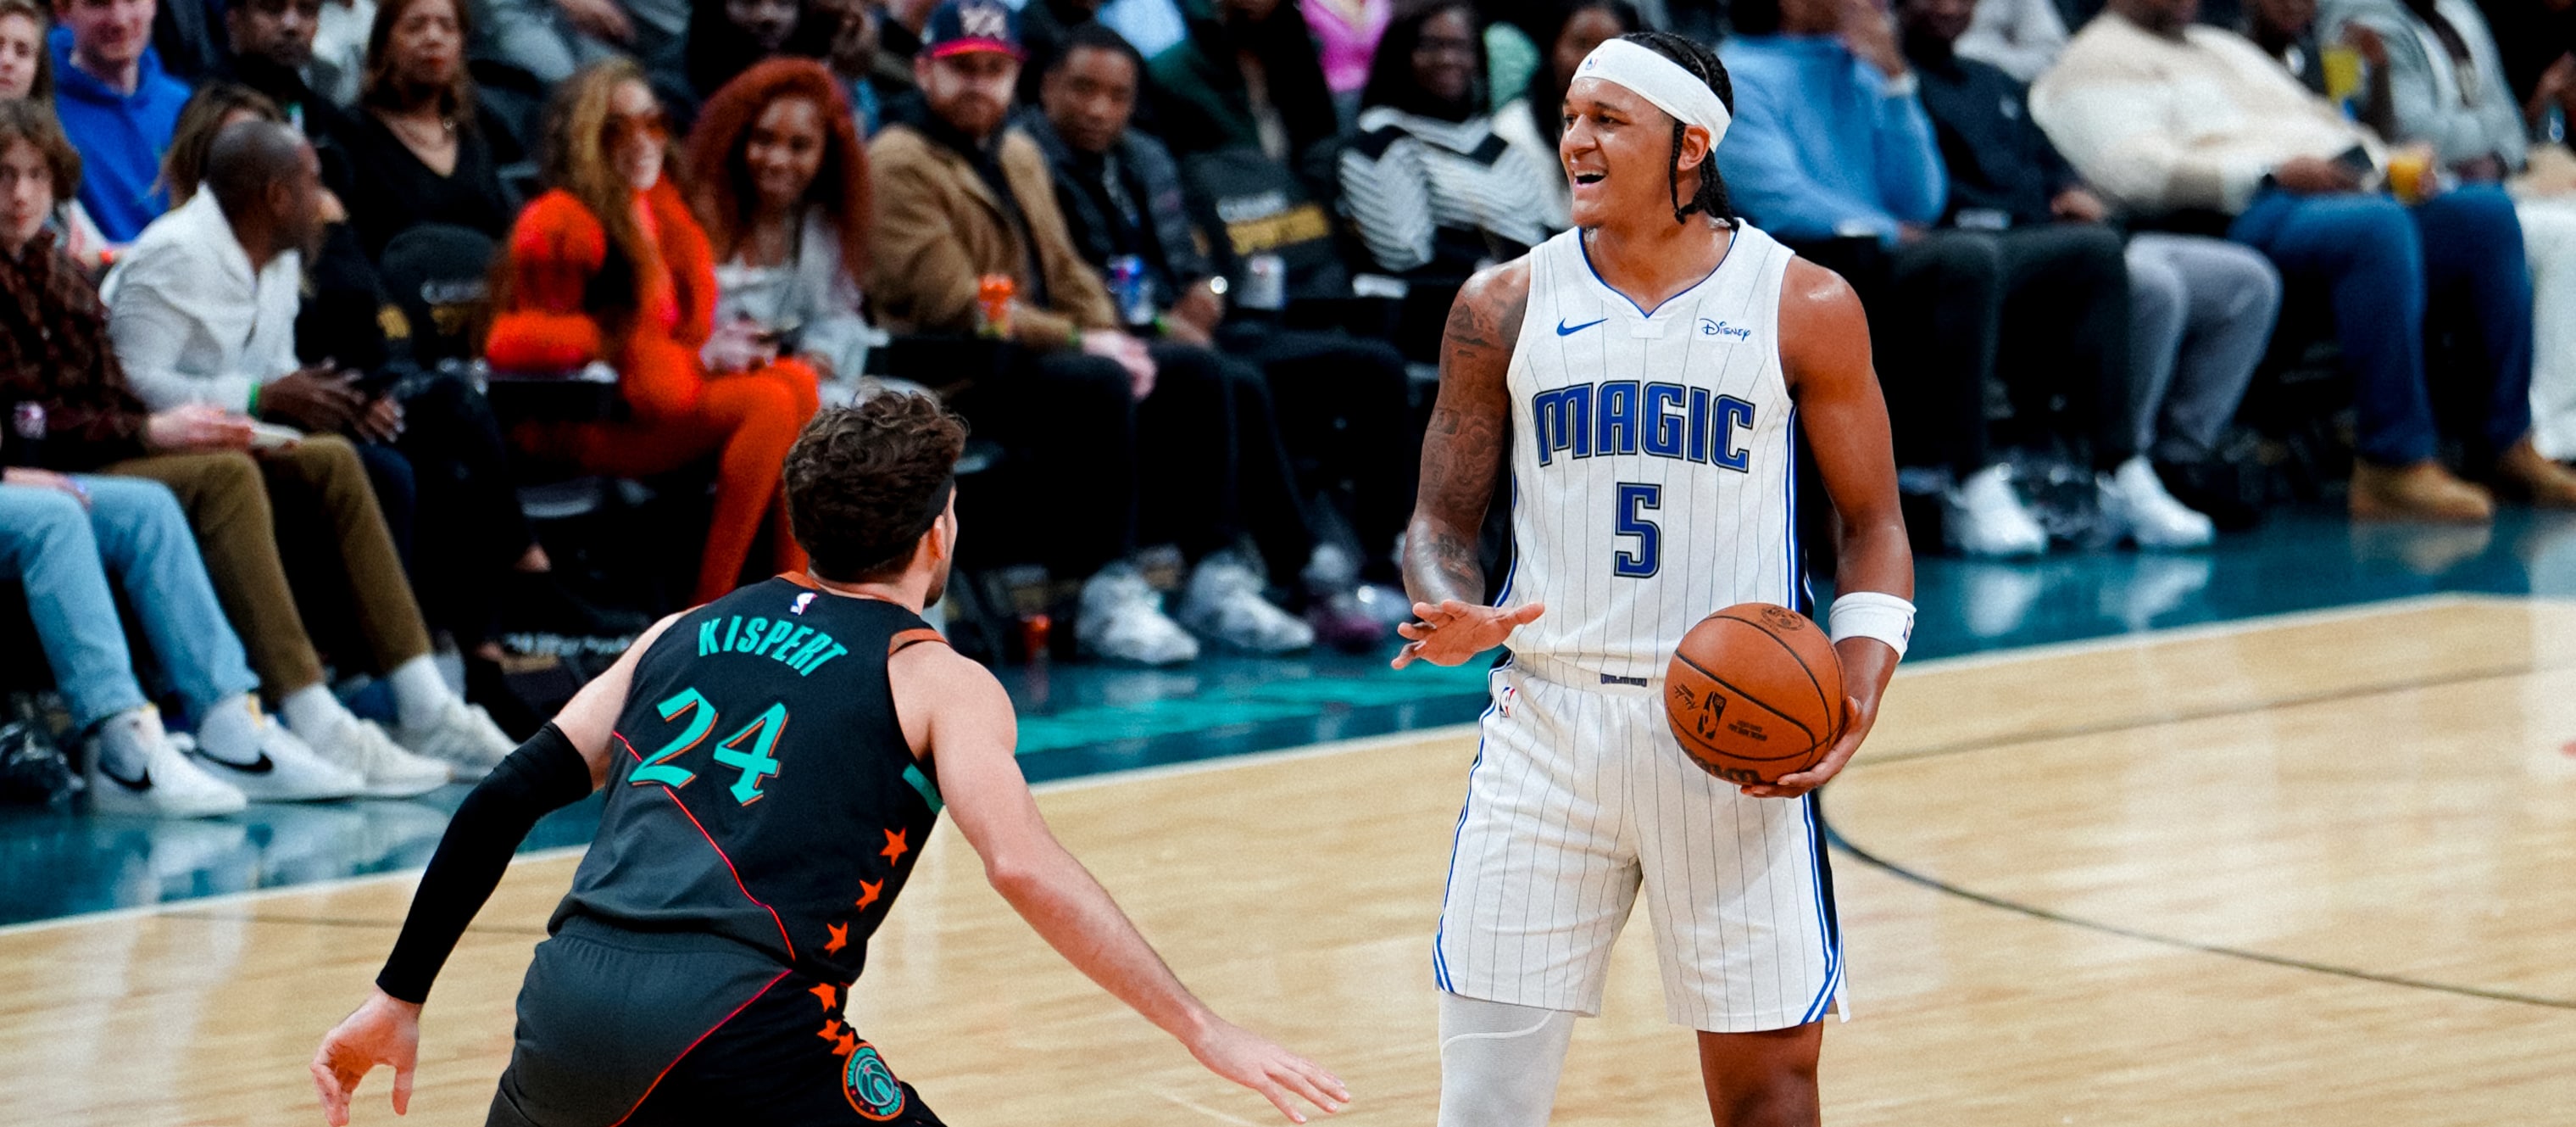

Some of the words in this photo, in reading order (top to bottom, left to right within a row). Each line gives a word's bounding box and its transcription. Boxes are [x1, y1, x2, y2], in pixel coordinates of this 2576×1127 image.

[1700, 318, 1751, 342] Disney
[1532, 380, 1755, 473] MAGIC
[1613, 482, 1661, 578] 5
[698, 616, 848, 676] KISPERT
[628, 687, 789, 806] 24
